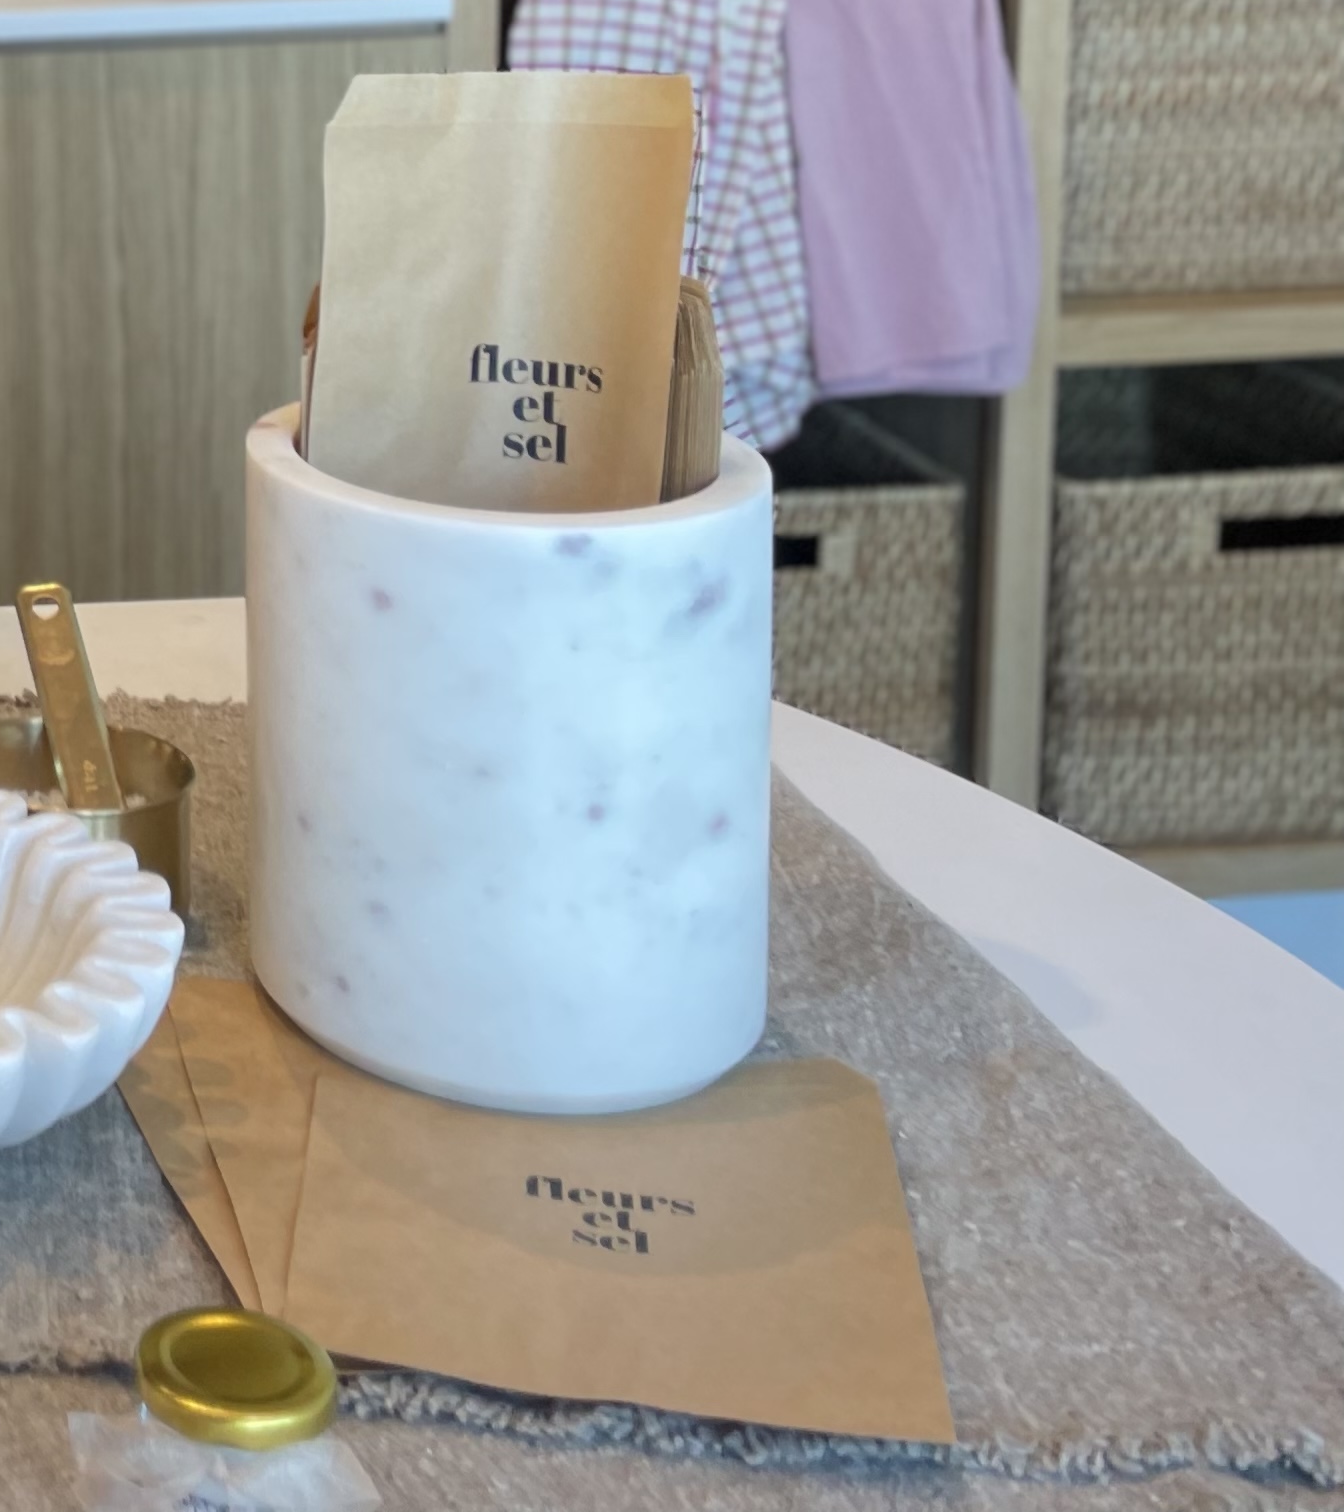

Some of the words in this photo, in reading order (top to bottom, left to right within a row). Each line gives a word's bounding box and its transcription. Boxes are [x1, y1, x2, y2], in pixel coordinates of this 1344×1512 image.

[468, 343, 604, 394] fleurs
[512, 391, 564, 426] et
[502, 424, 568, 465] sel
[525, 1174, 696, 1216] fleurs
[582, 1210, 637, 1233] et
[571, 1229, 650, 1254] sel
